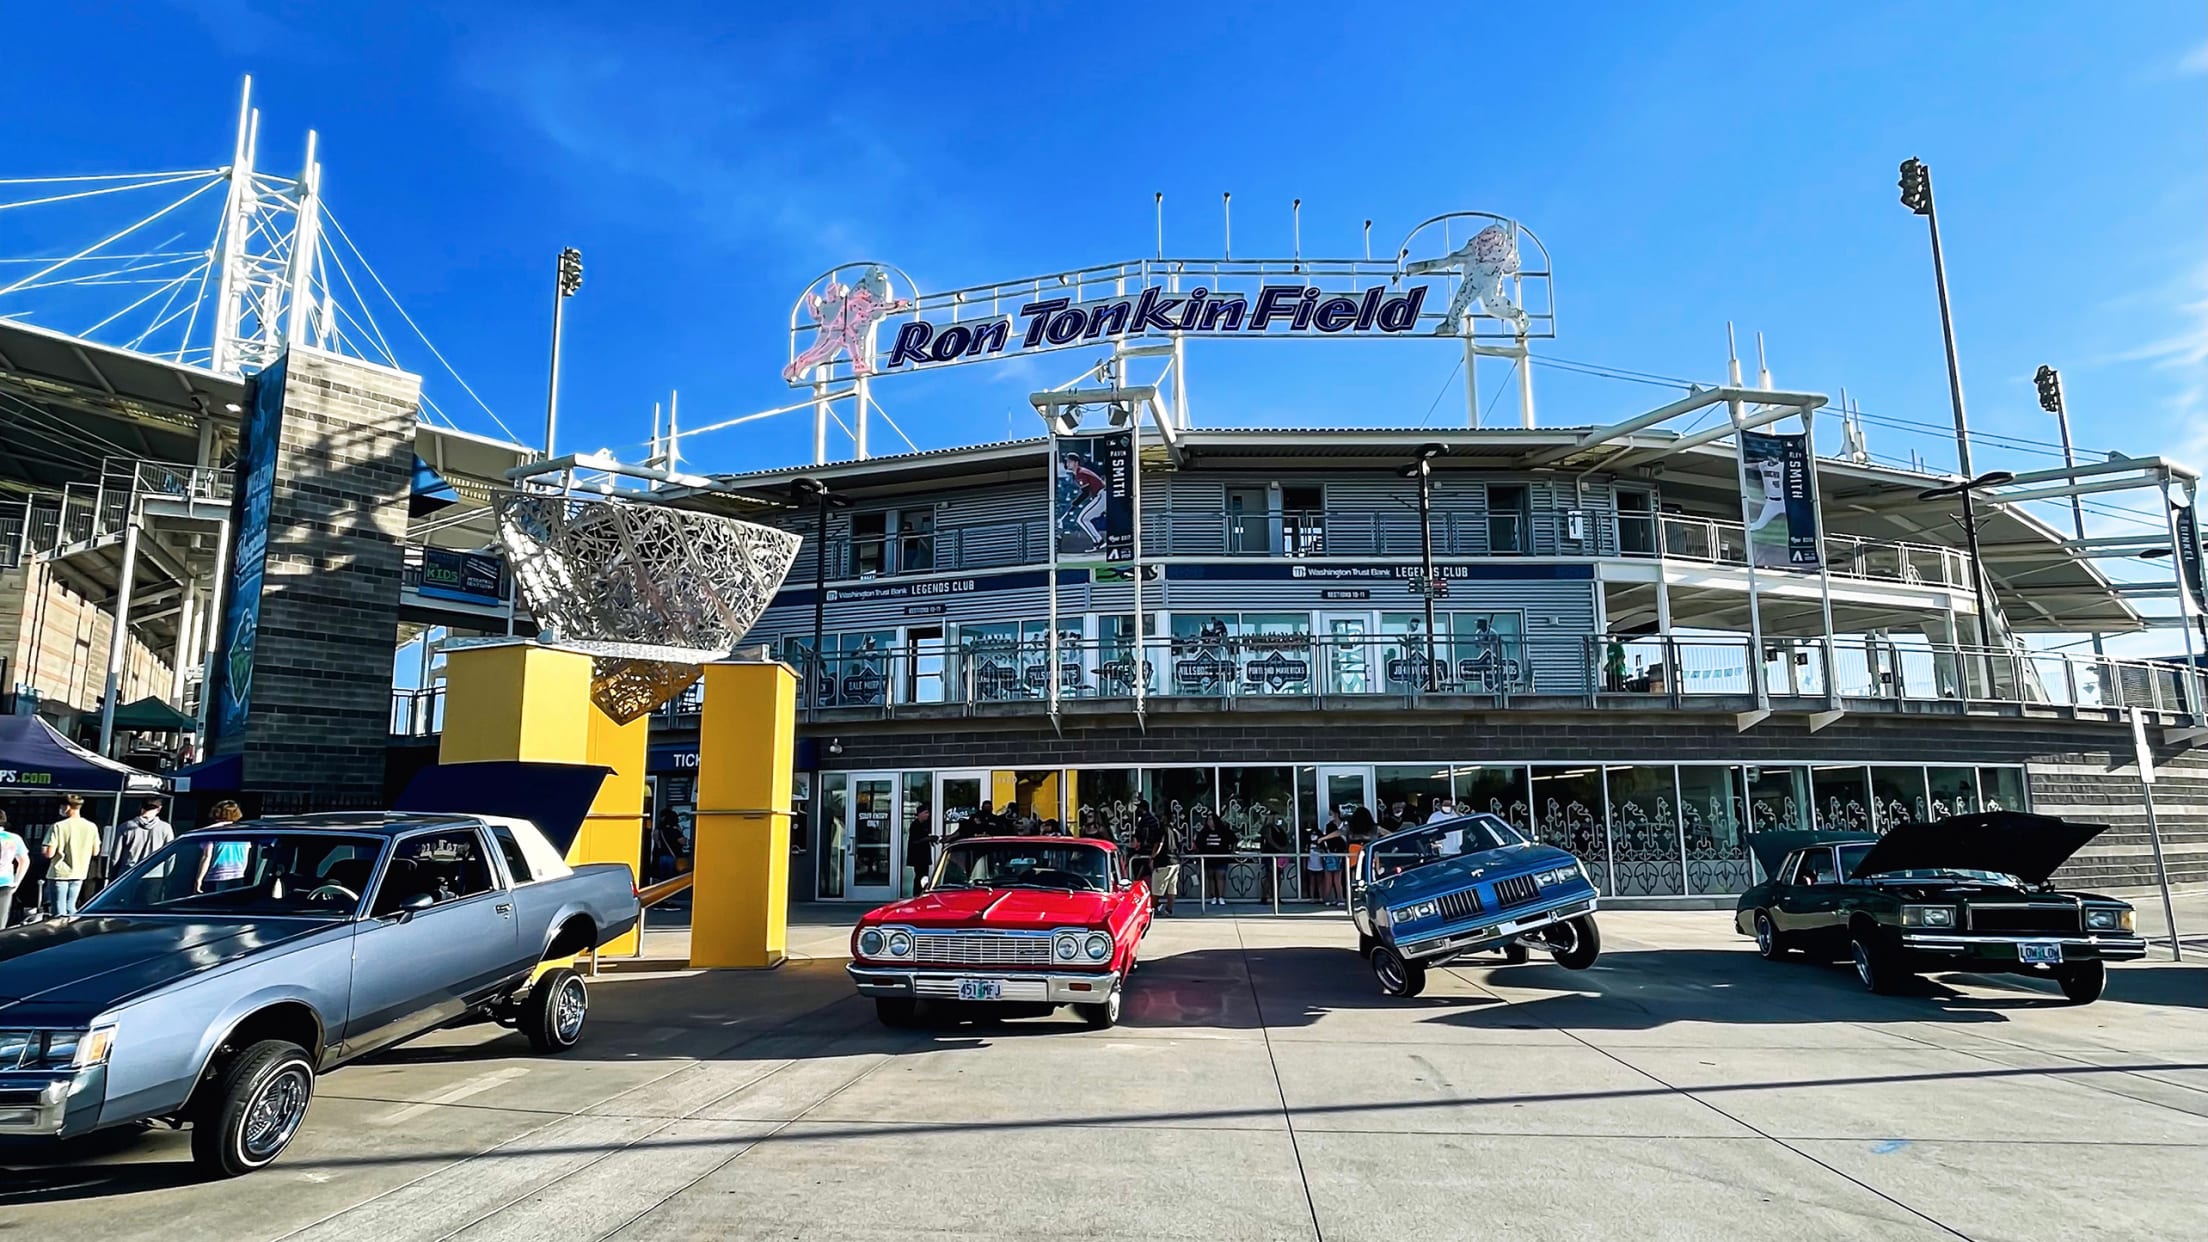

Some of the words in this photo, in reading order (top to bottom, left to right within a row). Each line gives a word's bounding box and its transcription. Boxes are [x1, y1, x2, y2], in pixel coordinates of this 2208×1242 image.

[887, 319, 1010, 368] Ron
[1020, 286, 1248, 347] Tonkin
[1248, 285, 1428, 333] Field
[1112, 459, 1125, 497] SMITH
[1789, 461, 1803, 499] SMITH
[426, 567, 458, 580] KIDS
[1307, 568, 1352, 578] Washington
[1352, 568, 1370, 576] Trust
[1371, 568, 1391, 576] Bank
[1395, 567, 1440, 577] LEGENS
[1443, 567, 1468, 577] CLUB
[838, 590, 875, 600] Washington
[875, 589, 890, 597] Trust
[890, 587, 908, 596] Bank
[911, 582, 950, 595] LEGENDS
[952, 580, 975, 592] CLUB
[960, 983, 976, 996] 451
